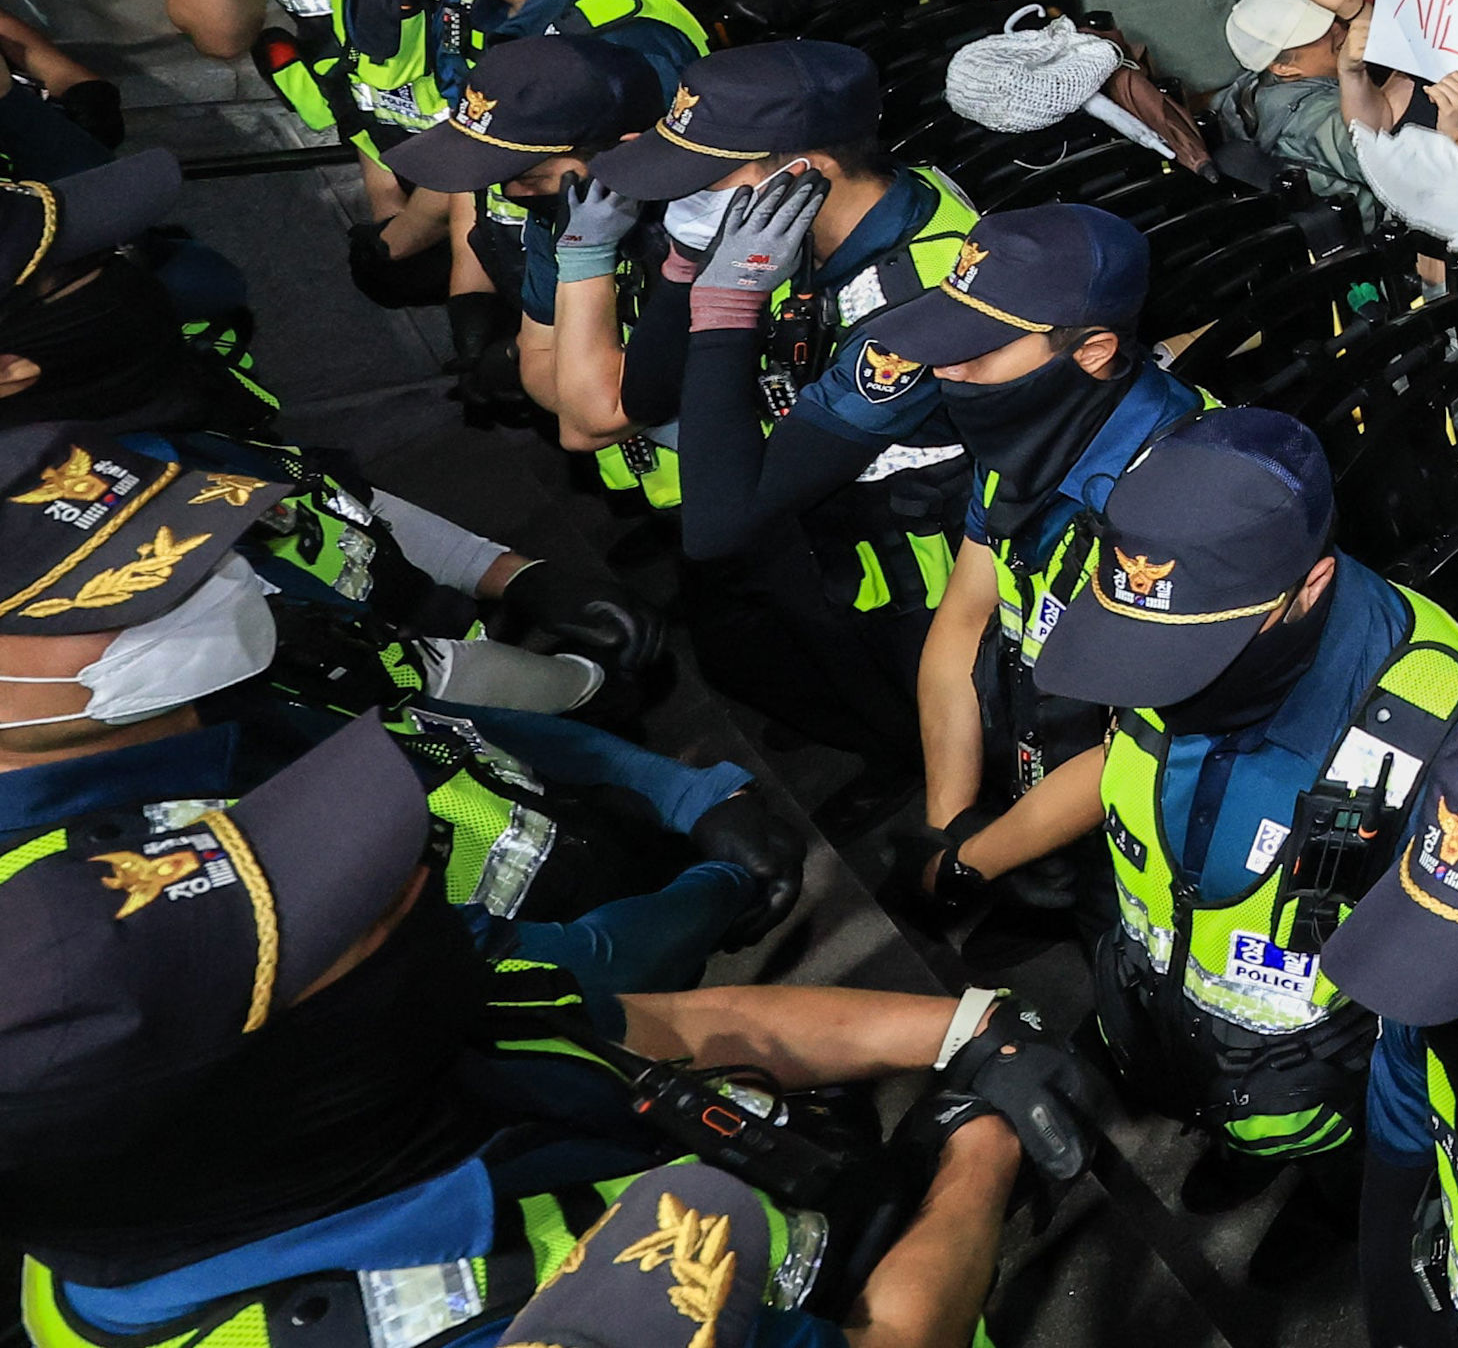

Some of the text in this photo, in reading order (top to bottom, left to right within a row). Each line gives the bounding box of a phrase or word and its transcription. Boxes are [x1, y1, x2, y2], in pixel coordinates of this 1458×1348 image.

[865, 381, 897, 394] POLICE
[1264, 827, 1291, 862] 경
[1235, 965, 1306, 994] POLICE
